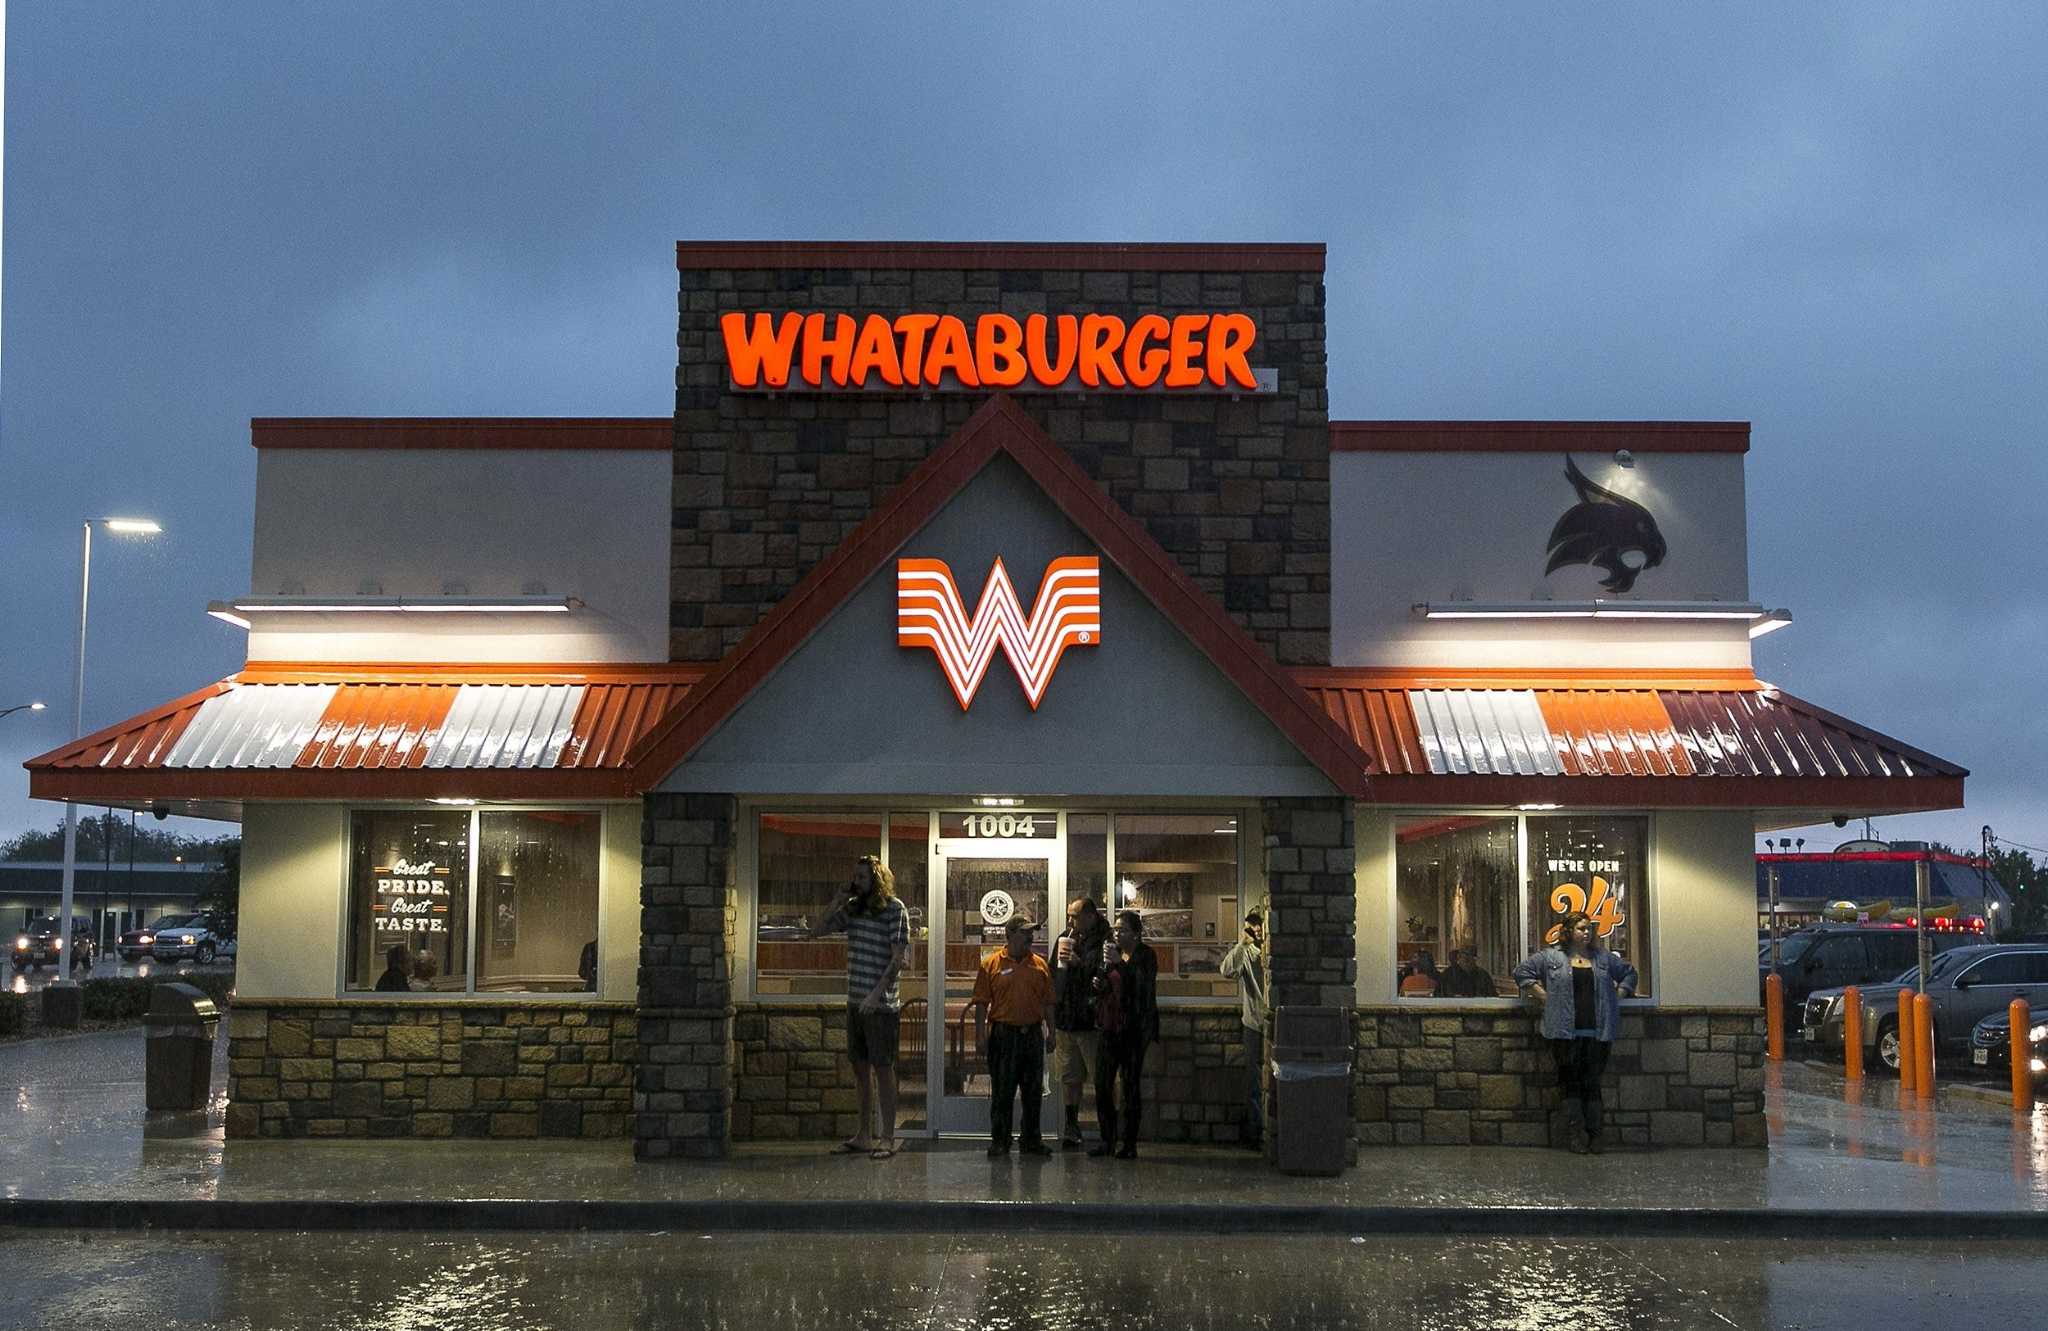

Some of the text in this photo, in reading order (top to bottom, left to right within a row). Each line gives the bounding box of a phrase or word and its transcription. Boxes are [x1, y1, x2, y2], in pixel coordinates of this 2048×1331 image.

[720, 312, 1258, 389] WHATABURGER
[963, 815, 1035, 837] 1004
[393, 858, 436, 875] Great
[1548, 859, 1620, 872] WE'RE OPEN
[377, 879, 450, 896] PRIDE.
[391, 897, 433, 913] Great
[1545, 875, 1625, 945] 24
[375, 917, 447, 932] TASTE.
